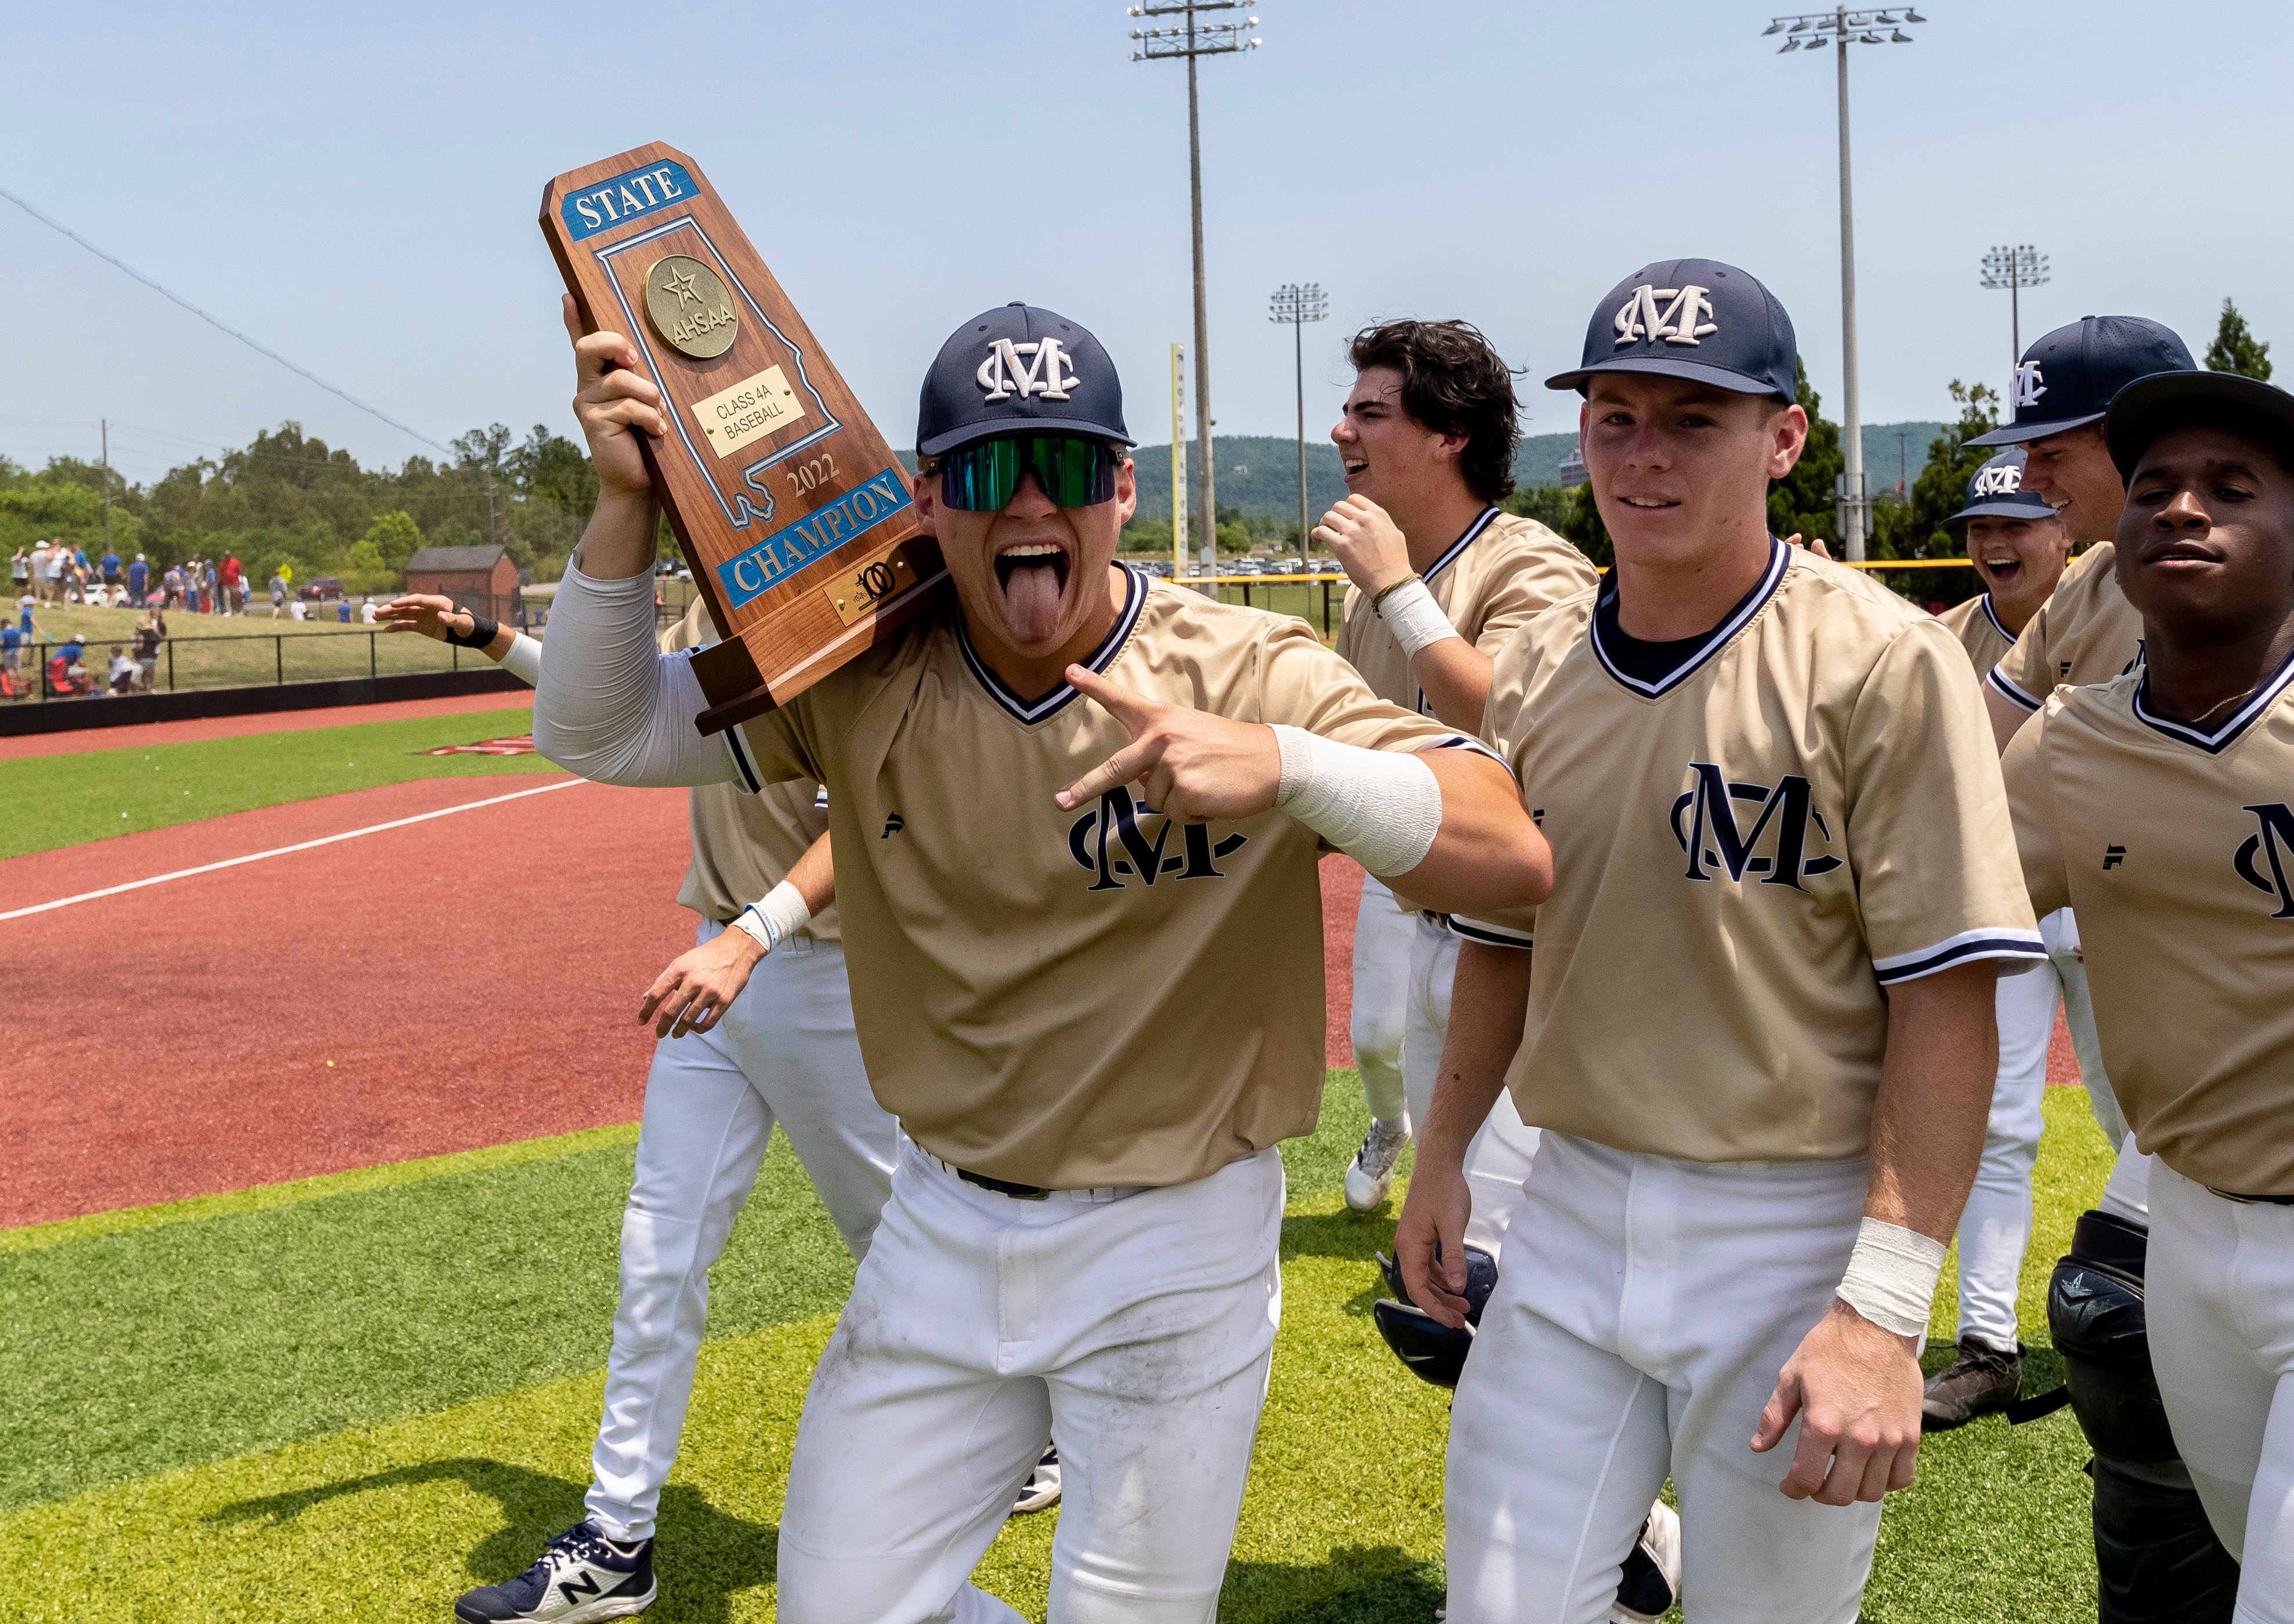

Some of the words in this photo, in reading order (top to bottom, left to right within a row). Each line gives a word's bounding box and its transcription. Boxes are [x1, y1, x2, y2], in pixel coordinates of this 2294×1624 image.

[576, 166, 682, 230] STATE
[672, 304, 736, 344] AHSAA
[717, 391, 755, 419] CLASS
[757, 384, 772, 400] 4A
[723, 402, 784, 440] BASEBALL
[787, 453, 841, 498] 2022
[733, 477, 899, 592] CHAMPION
[558, 1571, 602, 1605] N
